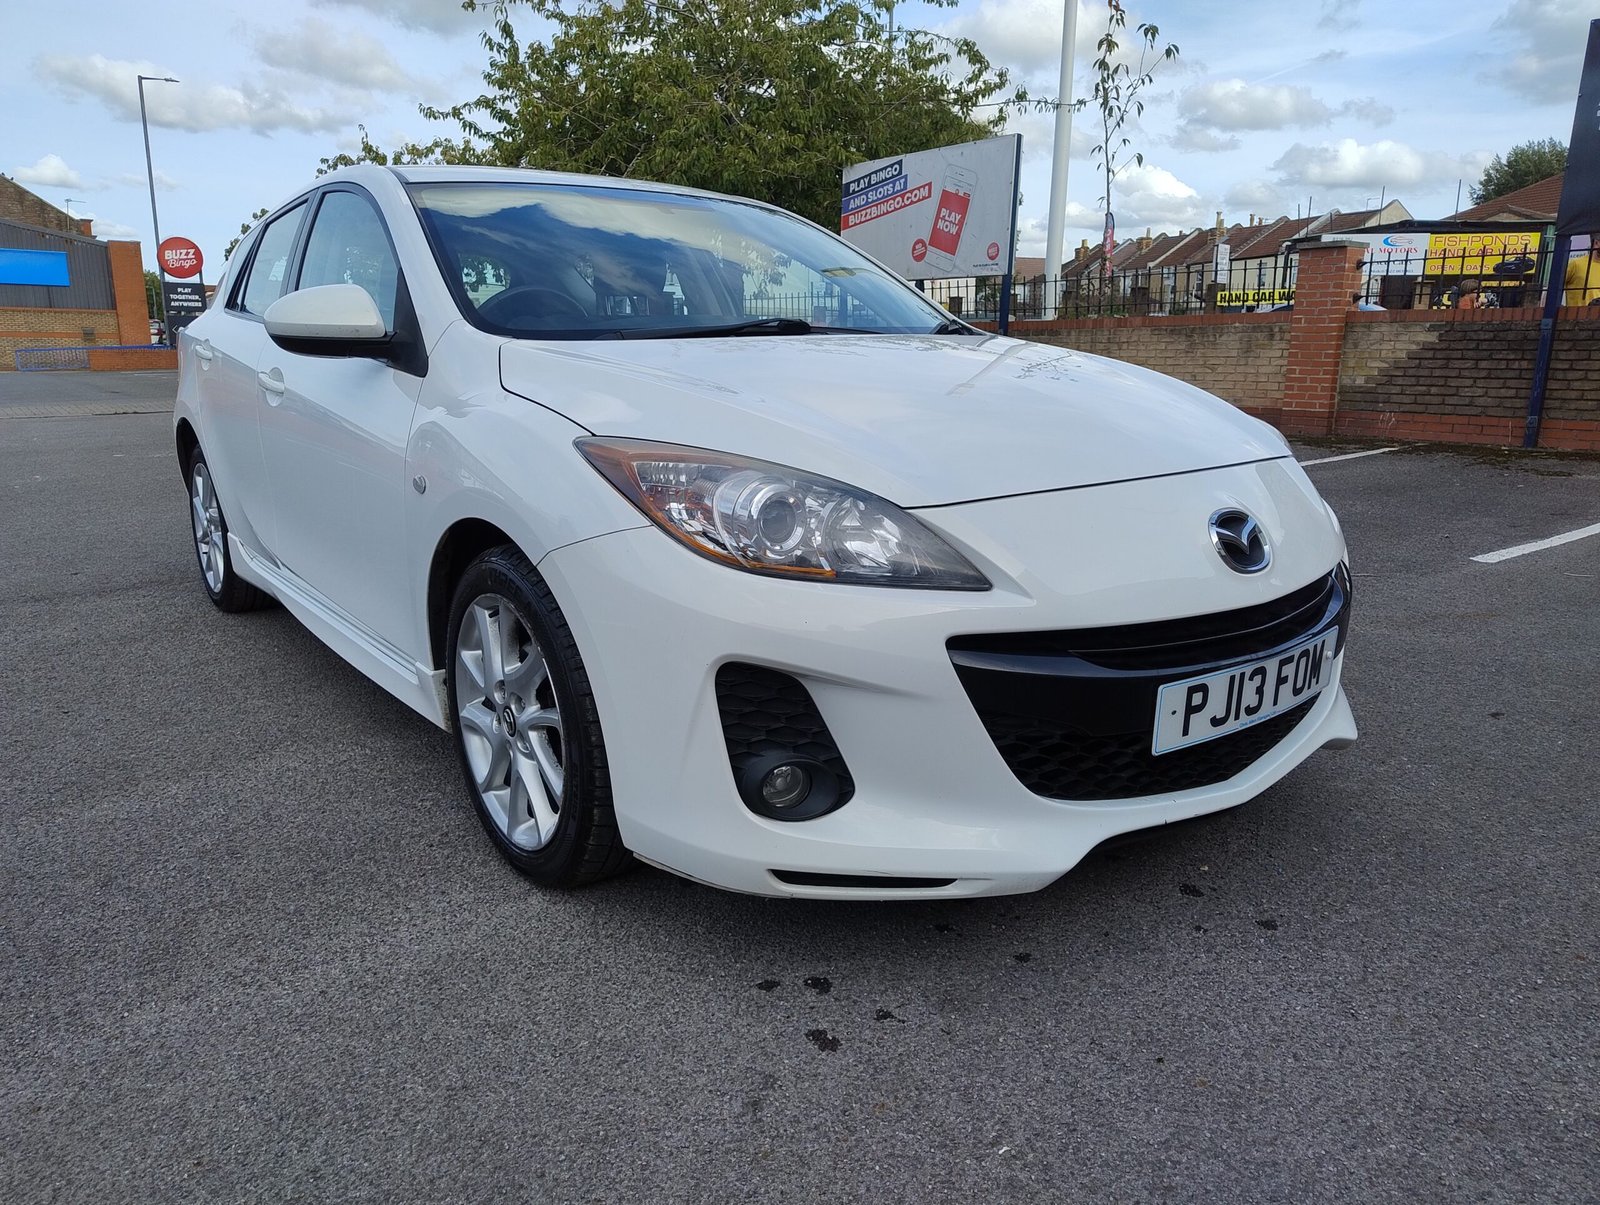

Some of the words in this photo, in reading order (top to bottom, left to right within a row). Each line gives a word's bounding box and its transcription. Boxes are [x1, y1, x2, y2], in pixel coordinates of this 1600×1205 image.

[849, 175, 870, 194] PLAY
[871, 164, 899, 186] BINGO
[848, 195, 866, 210] AND
[867, 185, 893, 204] SLOTS
[893, 178, 905, 193] AT
[848, 185, 929, 227] BUZZBINGO.COM
[940, 207, 962, 223] PLAY
[936, 218, 959, 236] NOW
[1433, 234, 1531, 247] FISHPONDS
[165, 249, 195, 259] BUZZ
[1429, 248, 1465, 257] HAND
[1468, 247, 1494, 256] CAR
[168, 259, 197, 268] Bingo
[1219, 291, 1249, 304] HAND
[1252, 290, 1275, 303] CAR
[1278, 289, 1297, 302] WA
[1181, 665, 1268, 738] PJ13
[1272, 639, 1327, 707] FOM
